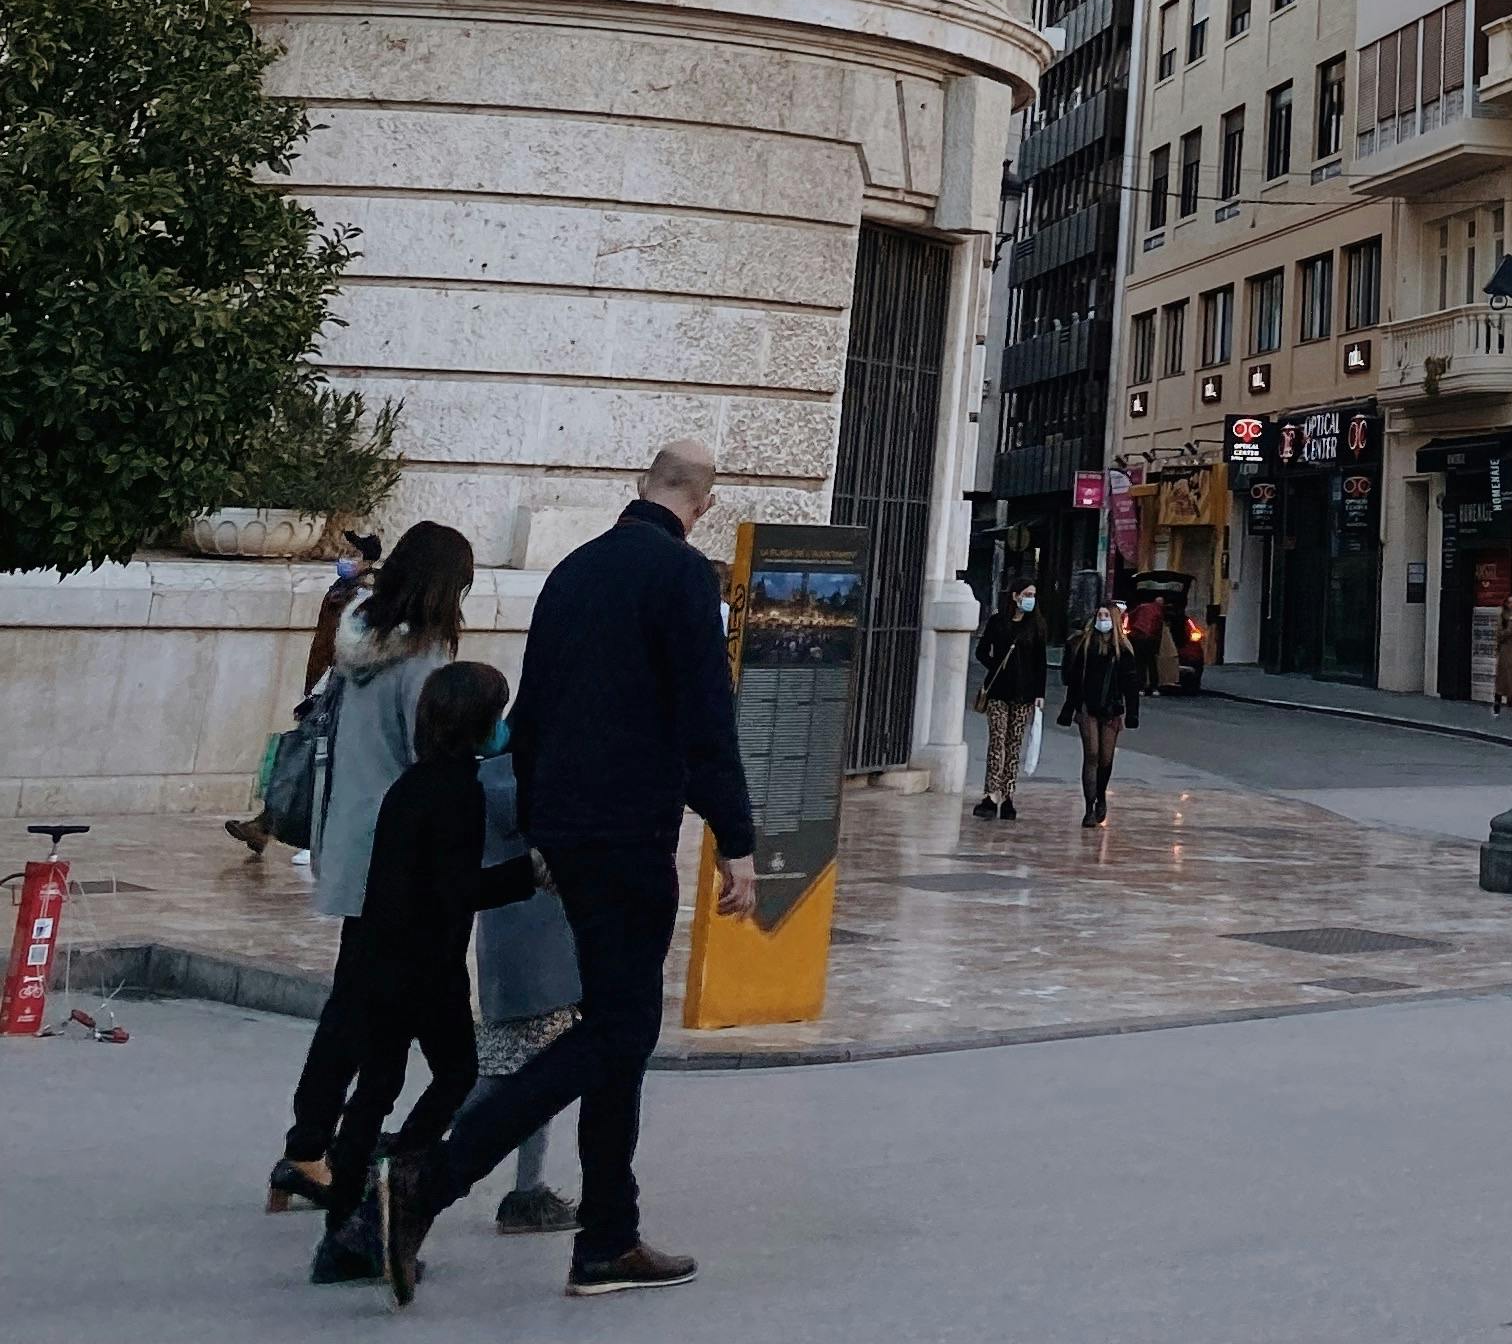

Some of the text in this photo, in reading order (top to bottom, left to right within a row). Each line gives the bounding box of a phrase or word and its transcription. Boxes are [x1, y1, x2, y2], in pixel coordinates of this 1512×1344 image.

[1304, 412, 1340, 437] OPTICAL
[1304, 437, 1338, 462] CENTER
[1490, 459, 1502, 511] HOMENAJE
